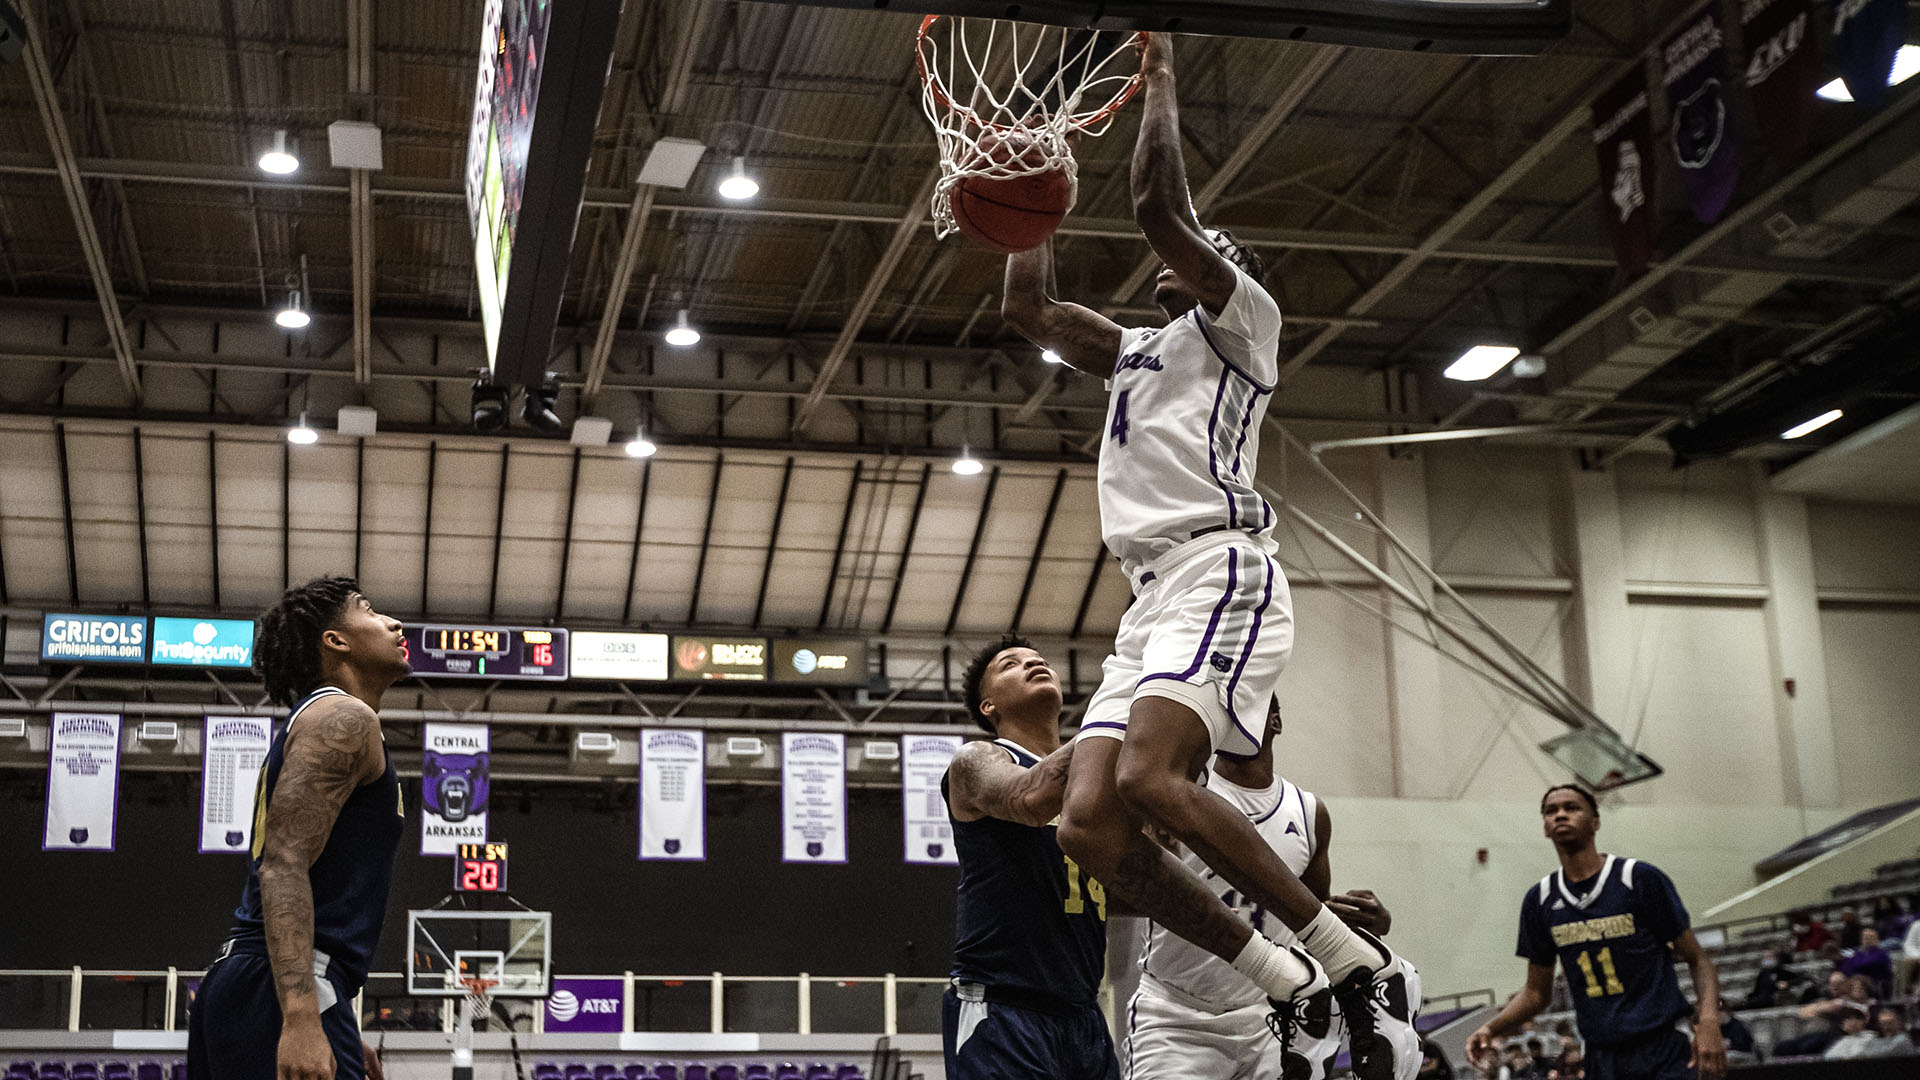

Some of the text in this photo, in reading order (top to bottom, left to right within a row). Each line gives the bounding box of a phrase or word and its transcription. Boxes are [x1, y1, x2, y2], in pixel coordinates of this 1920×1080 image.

[1110, 389, 1131, 448] 4
[50, 620, 143, 645] GRIFOLS
[441, 629, 499, 652] 11:54
[48, 641, 142, 657] grifolsplasma.com
[533, 644, 553, 666] 16
[434, 736, 480, 748] CENTRAL
[425, 825, 483, 838] ARKANSAS
[462, 861, 499, 891] 20
[1576, 946, 1625, 998] 11
[581, 998, 620, 1014] AT&T
